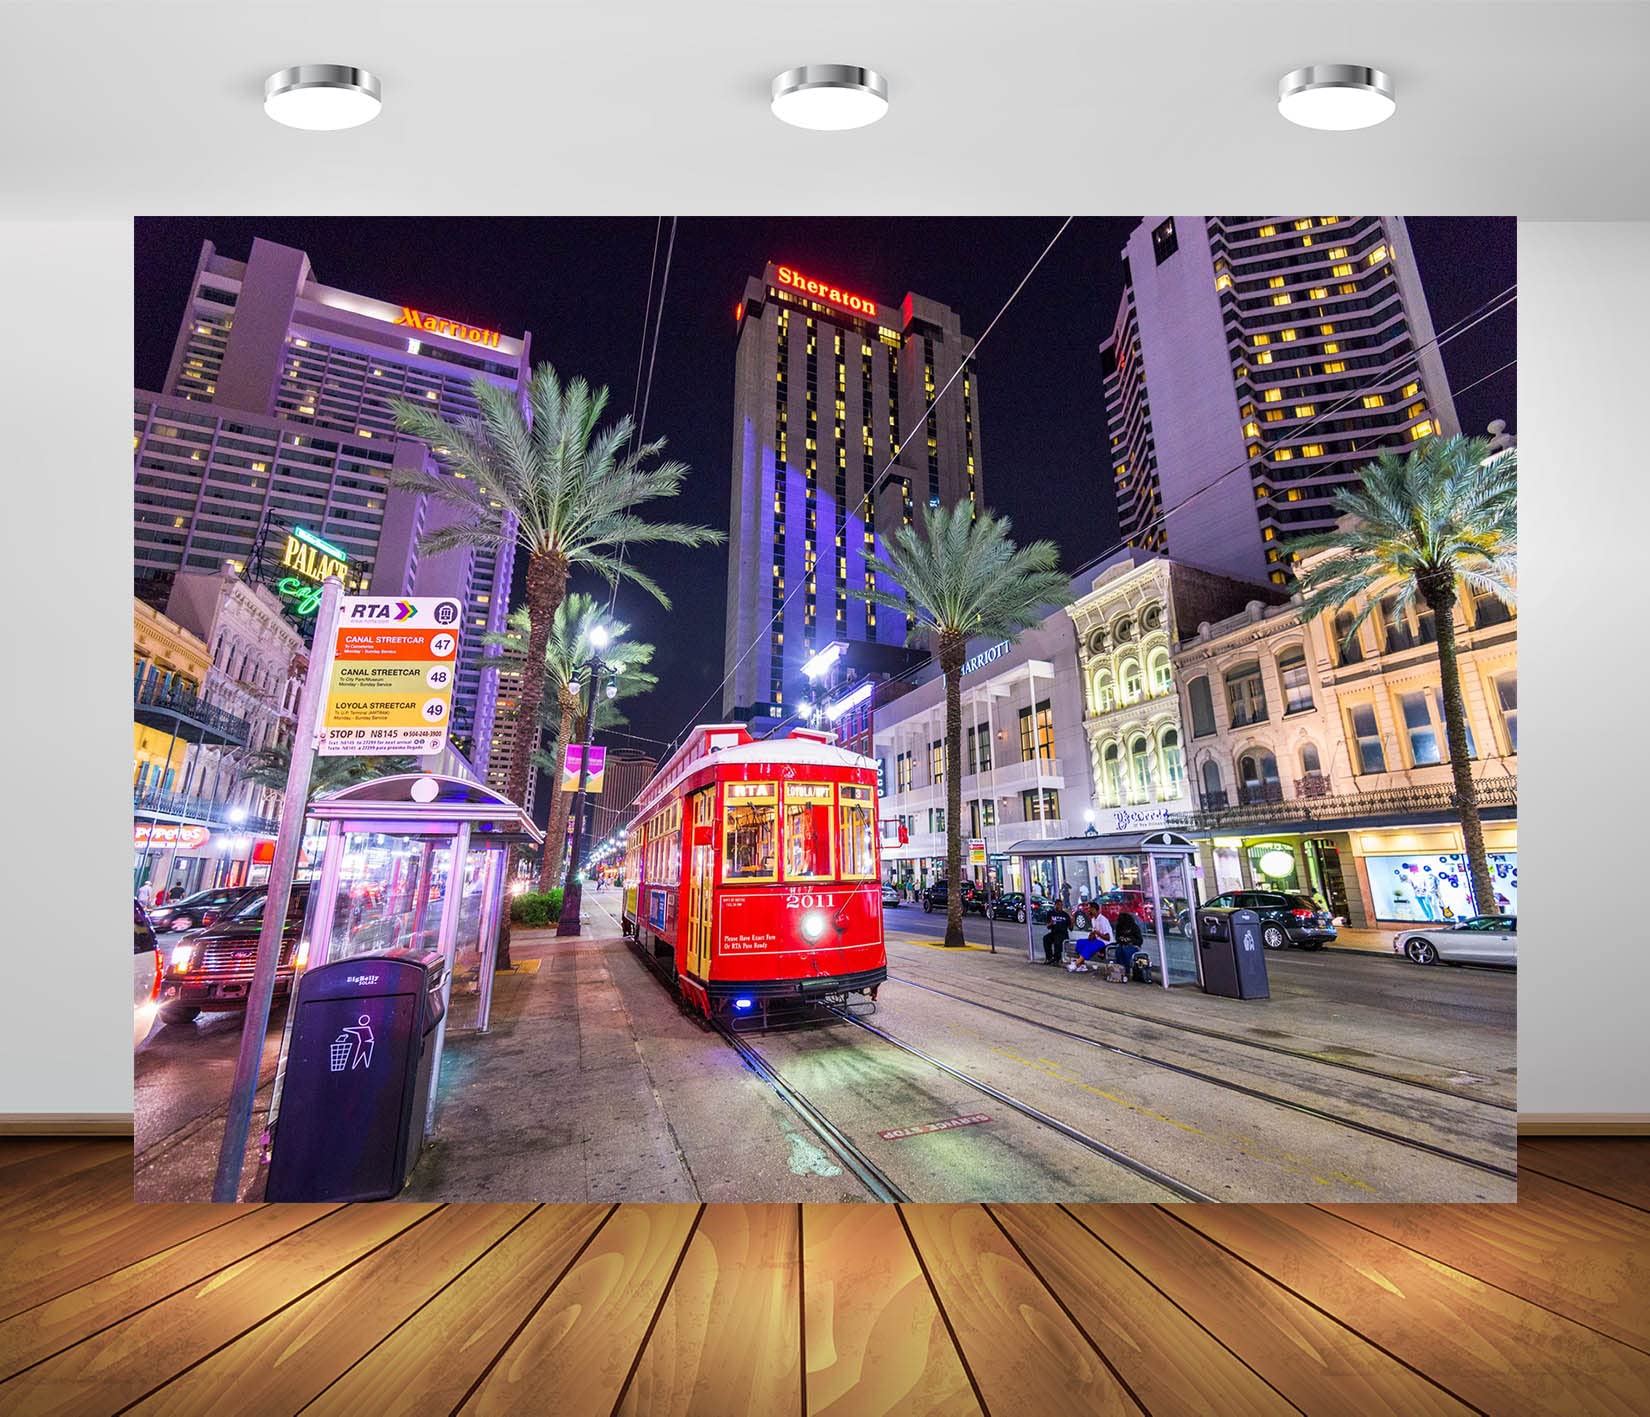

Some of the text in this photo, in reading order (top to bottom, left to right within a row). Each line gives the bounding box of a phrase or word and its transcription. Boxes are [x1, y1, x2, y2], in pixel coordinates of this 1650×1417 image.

[778, 265, 876, 317] Sheraton
[393, 307, 500, 348] Marriott
[278, 577, 323, 614] Caf
[351, 604, 390, 618] RTA
[376, 636, 425, 644] STREETCAR
[435, 639, 451, 650] 47
[431, 672, 447, 683] 48
[427, 704, 443, 716] 49
[330, 730, 399, 738] STOP ID N8145
[734, 785, 769, 797] RTA
[786, 894, 835, 909] 2011
